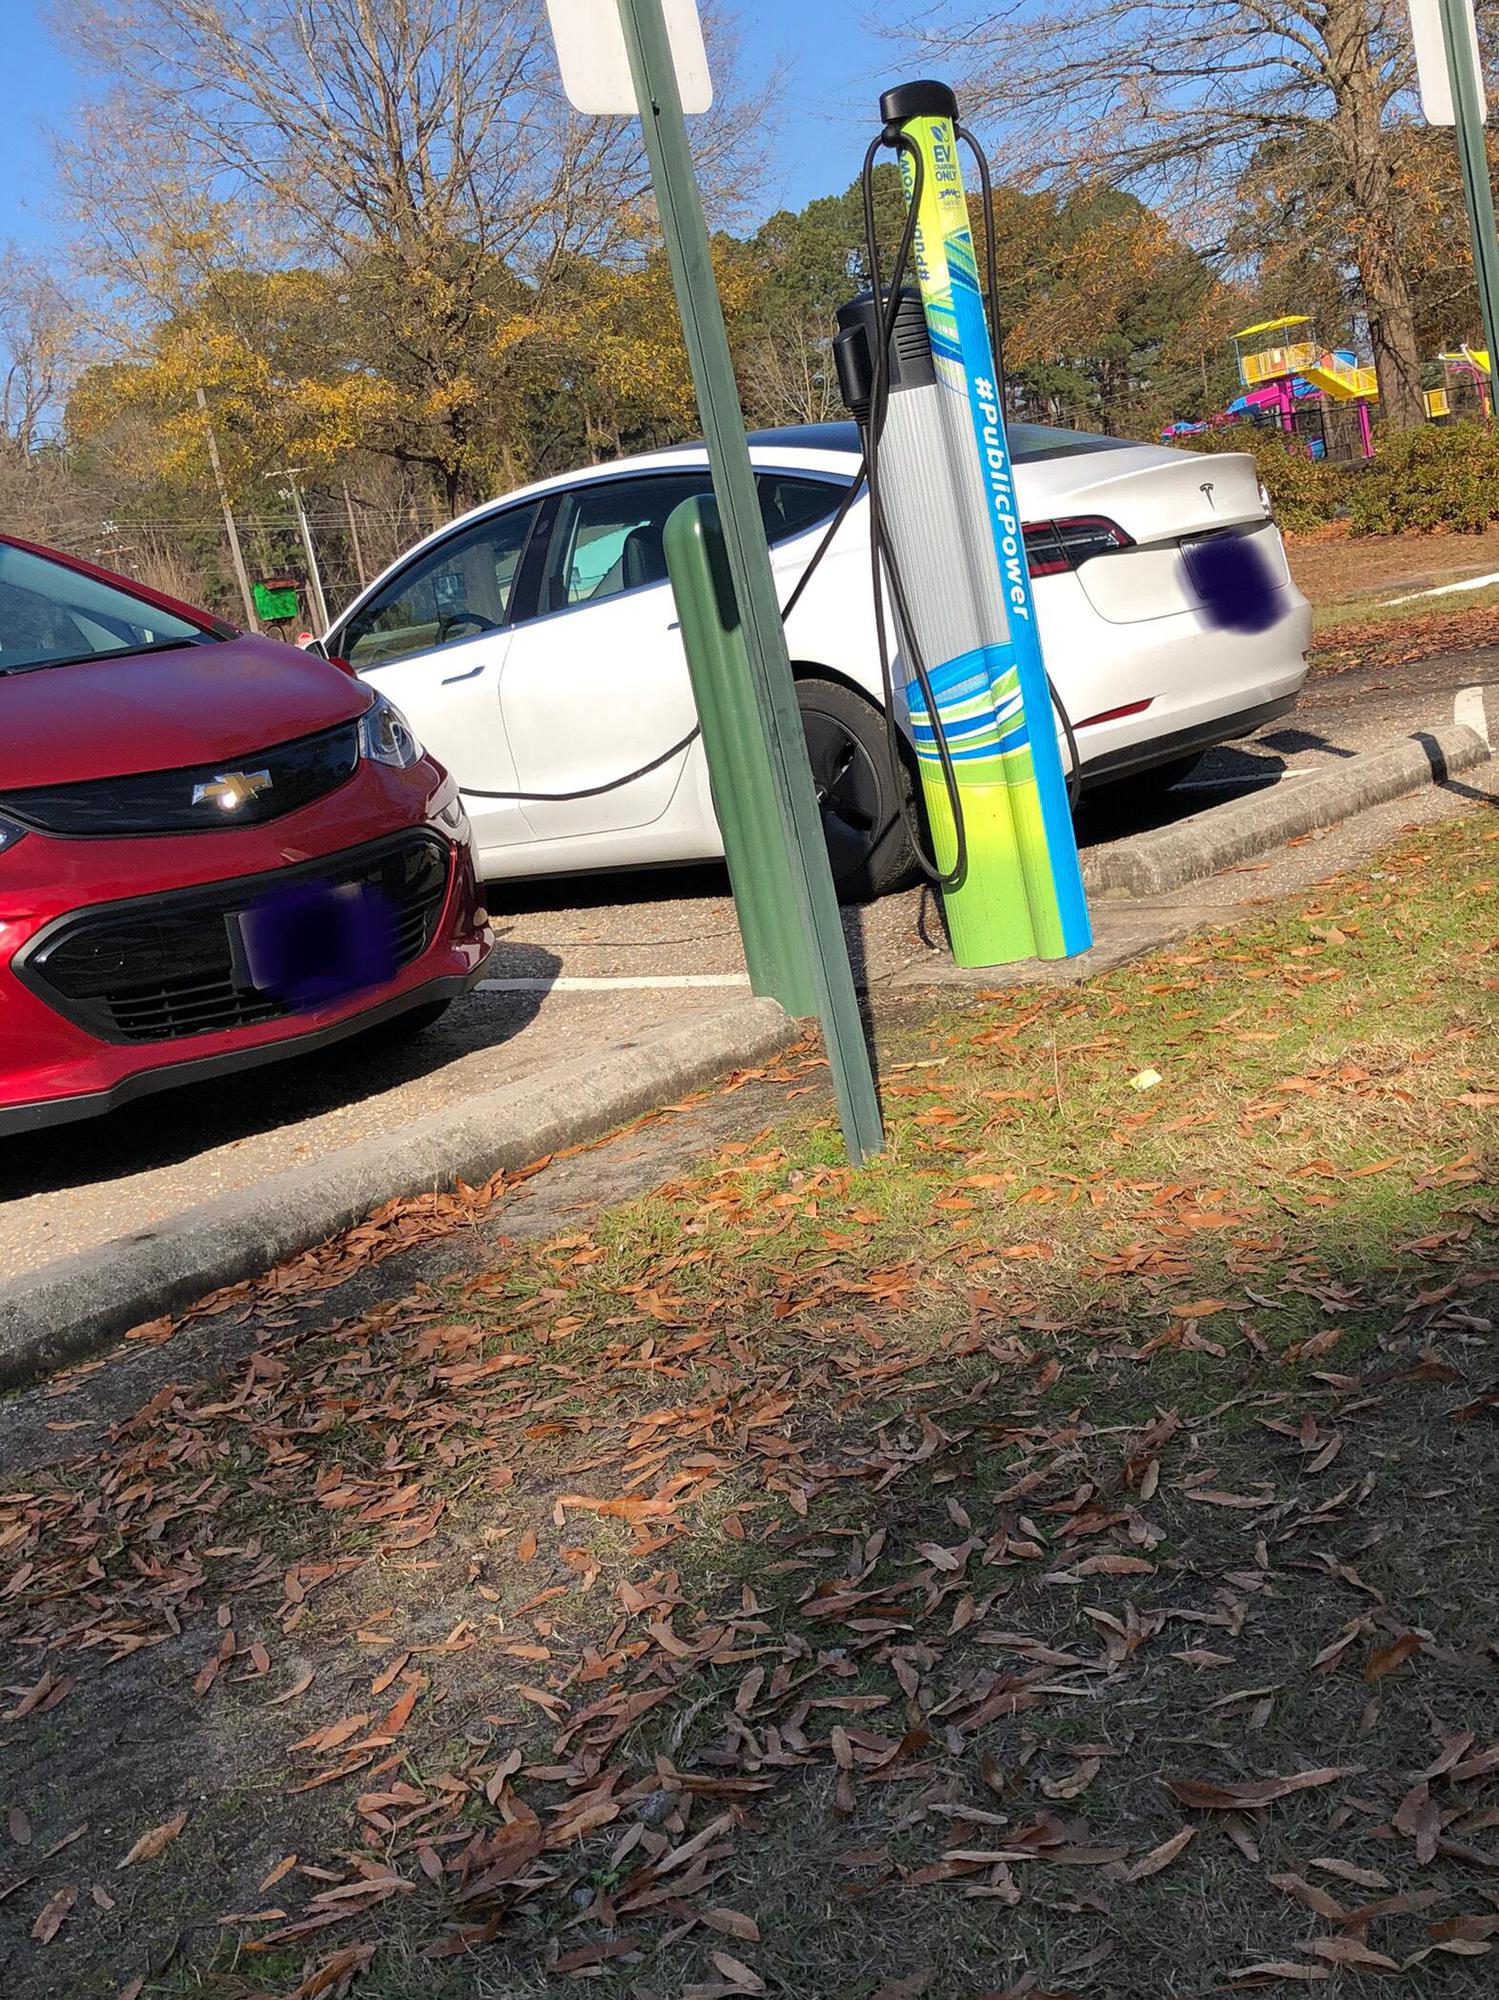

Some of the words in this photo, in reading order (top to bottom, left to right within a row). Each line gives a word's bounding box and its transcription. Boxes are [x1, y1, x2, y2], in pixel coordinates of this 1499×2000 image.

[933, 144, 951, 163] EV
[935, 170, 957, 181] ONLY
[974, 376, 1029, 620] #PublicPower
